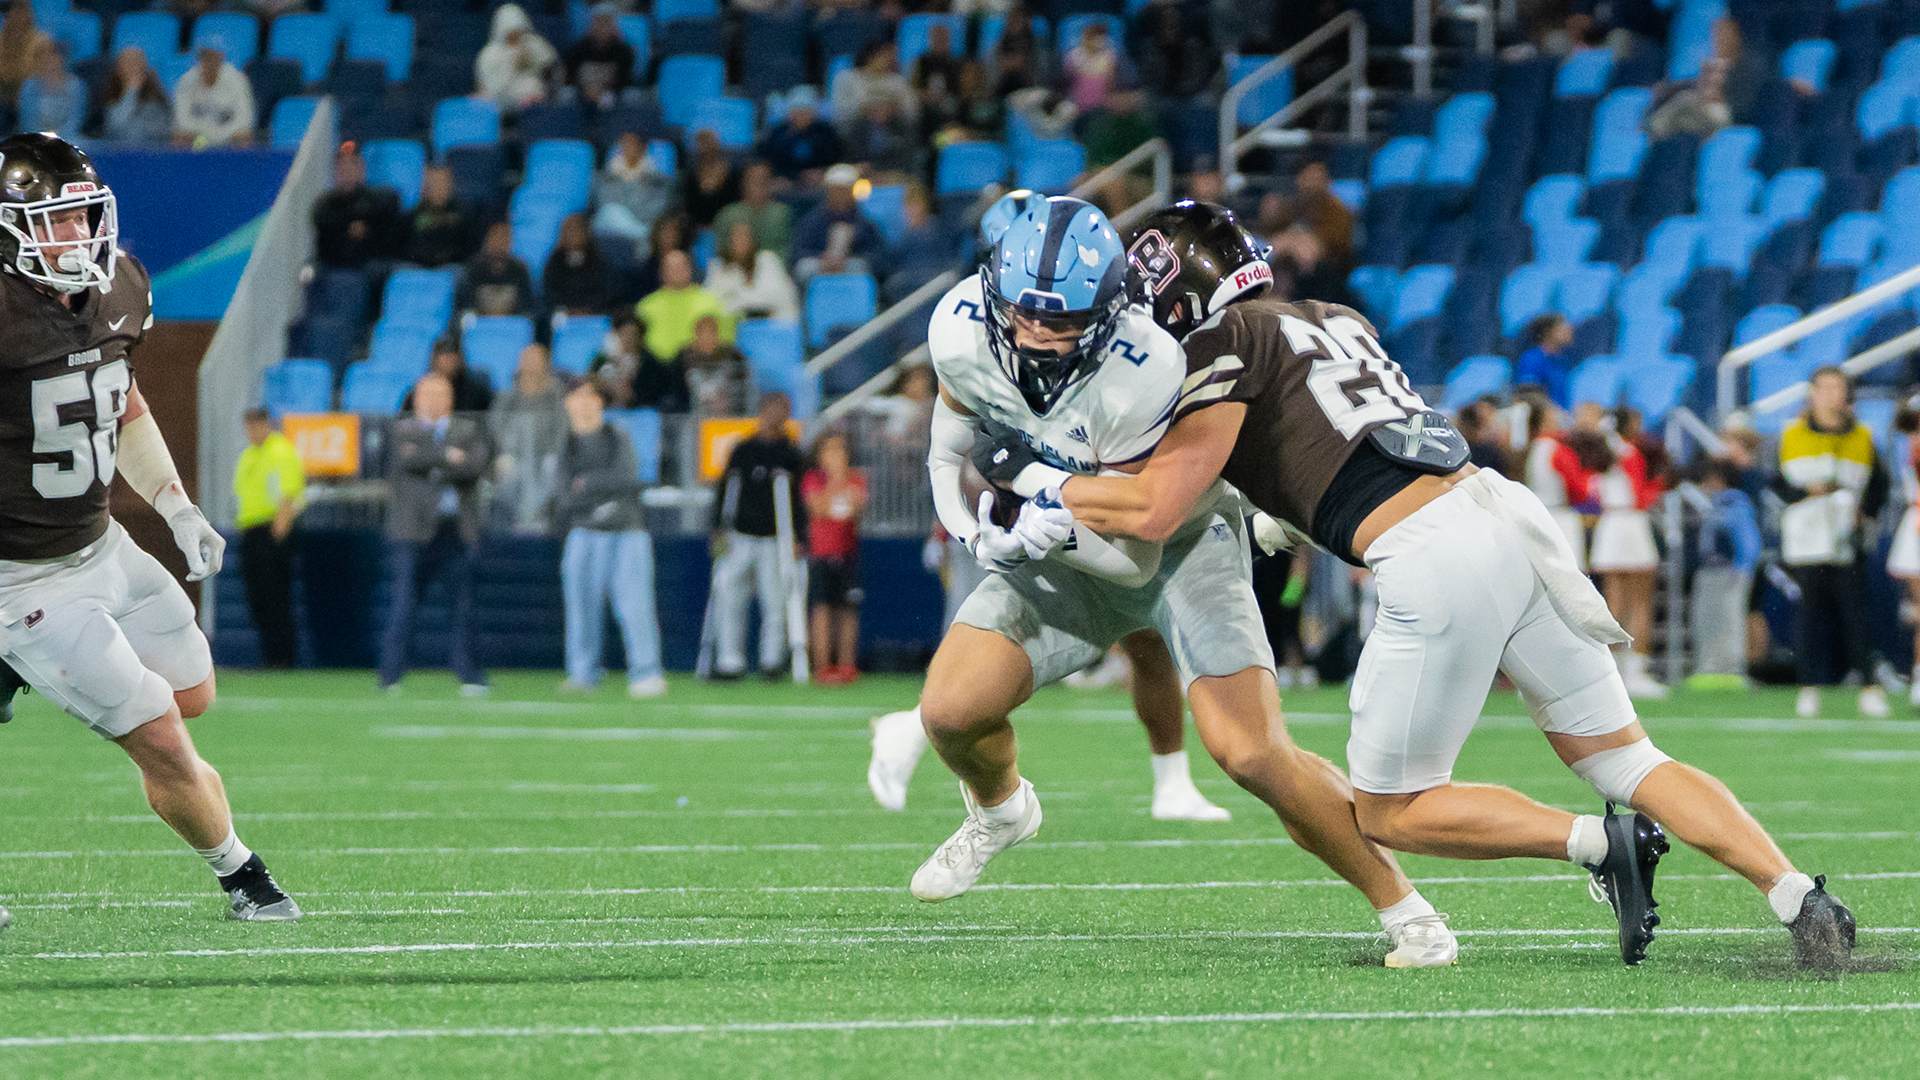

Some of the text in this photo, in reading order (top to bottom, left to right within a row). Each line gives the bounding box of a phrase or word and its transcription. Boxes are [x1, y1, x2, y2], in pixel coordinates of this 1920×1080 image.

[66, 183, 94, 193] BEARS
[953, 299, 985, 322] 2
[68, 348, 101, 366] BROWN
[1110, 339, 1149, 367] 2
[1277, 314, 1434, 441] 20
[31, 358, 130, 499] 58
